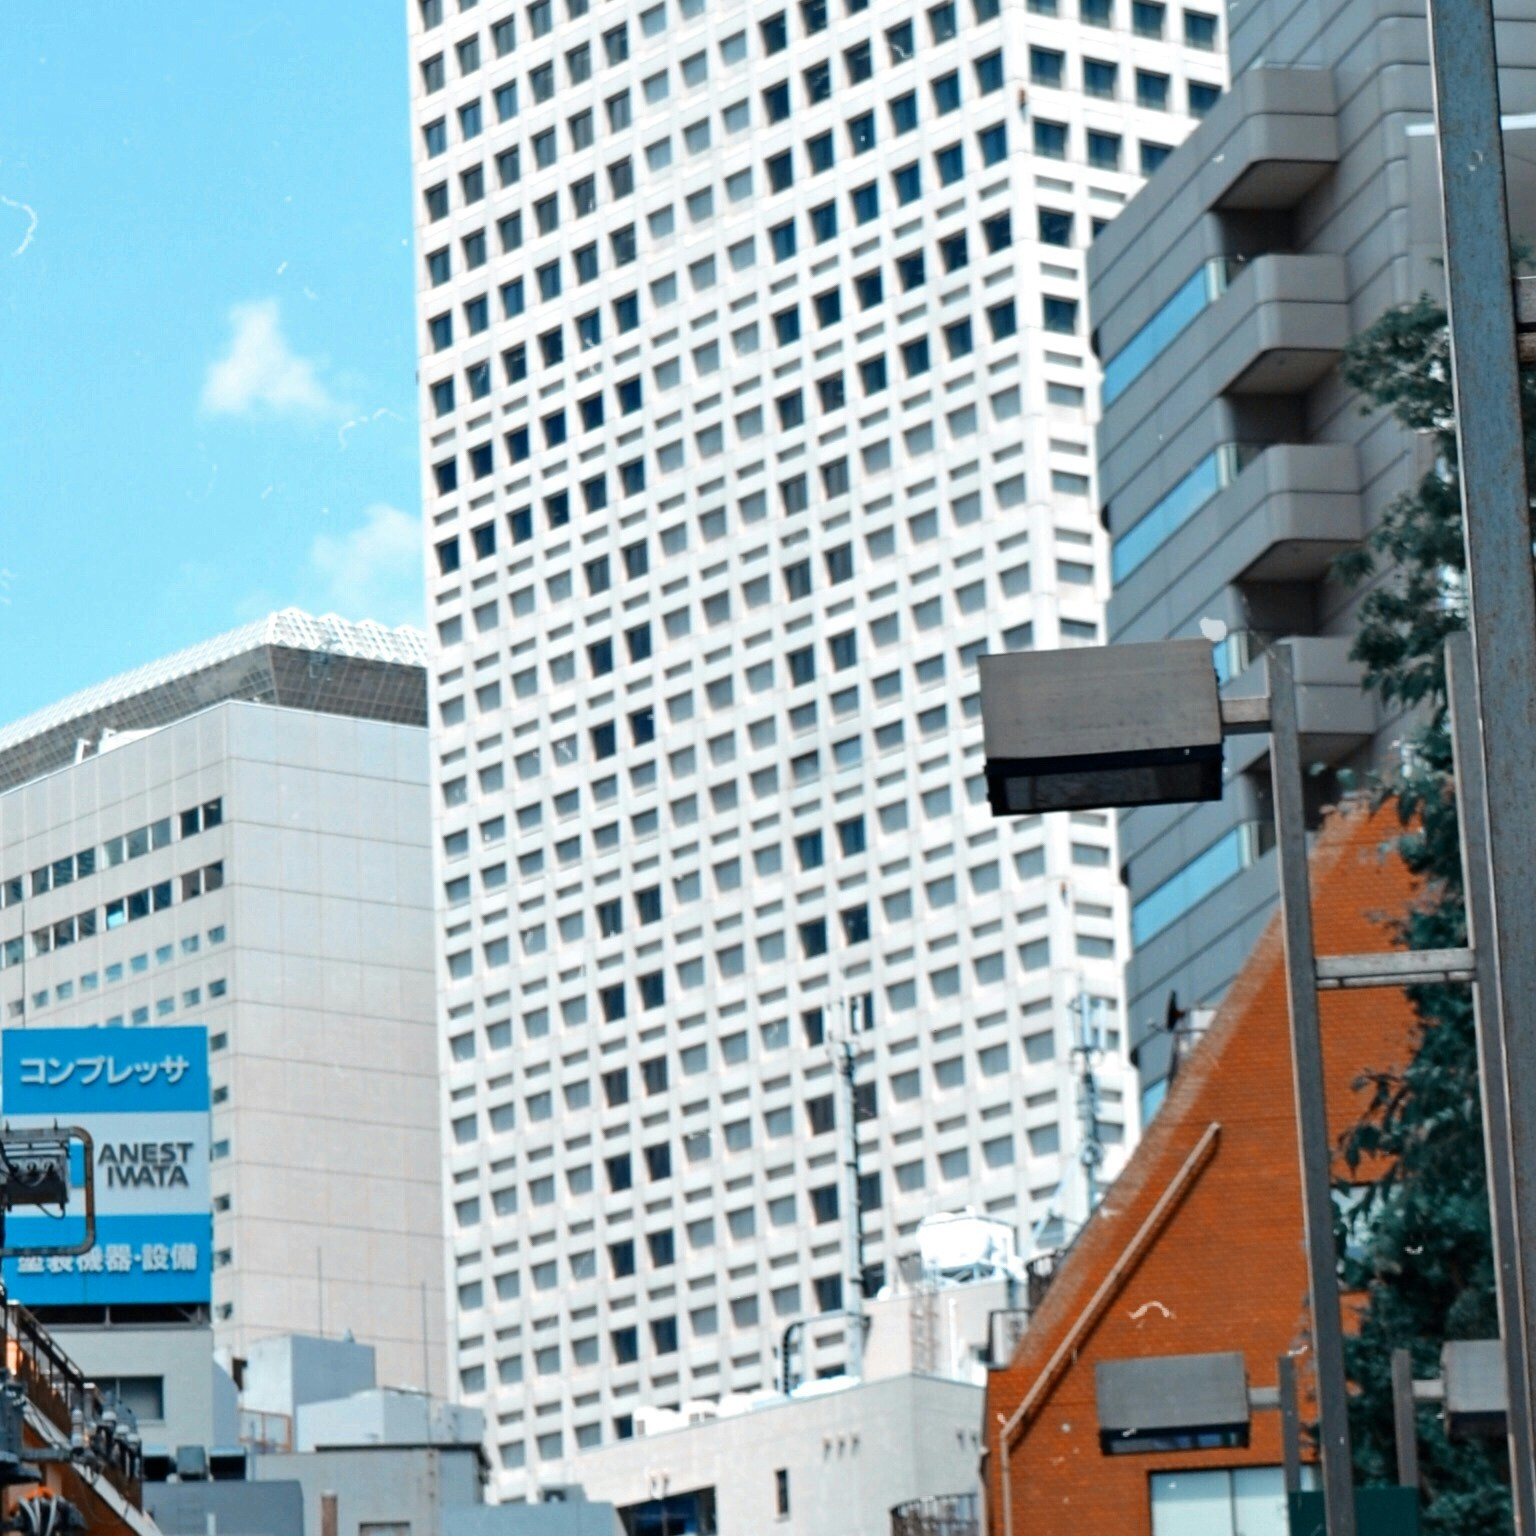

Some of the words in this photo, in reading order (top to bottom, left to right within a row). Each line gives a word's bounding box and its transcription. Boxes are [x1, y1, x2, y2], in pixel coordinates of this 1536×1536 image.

[20, 1054, 190, 1085] コンプレッサ
[98, 1142, 195, 1165] ANEST
[107, 1164, 189, 1188] IWATA
